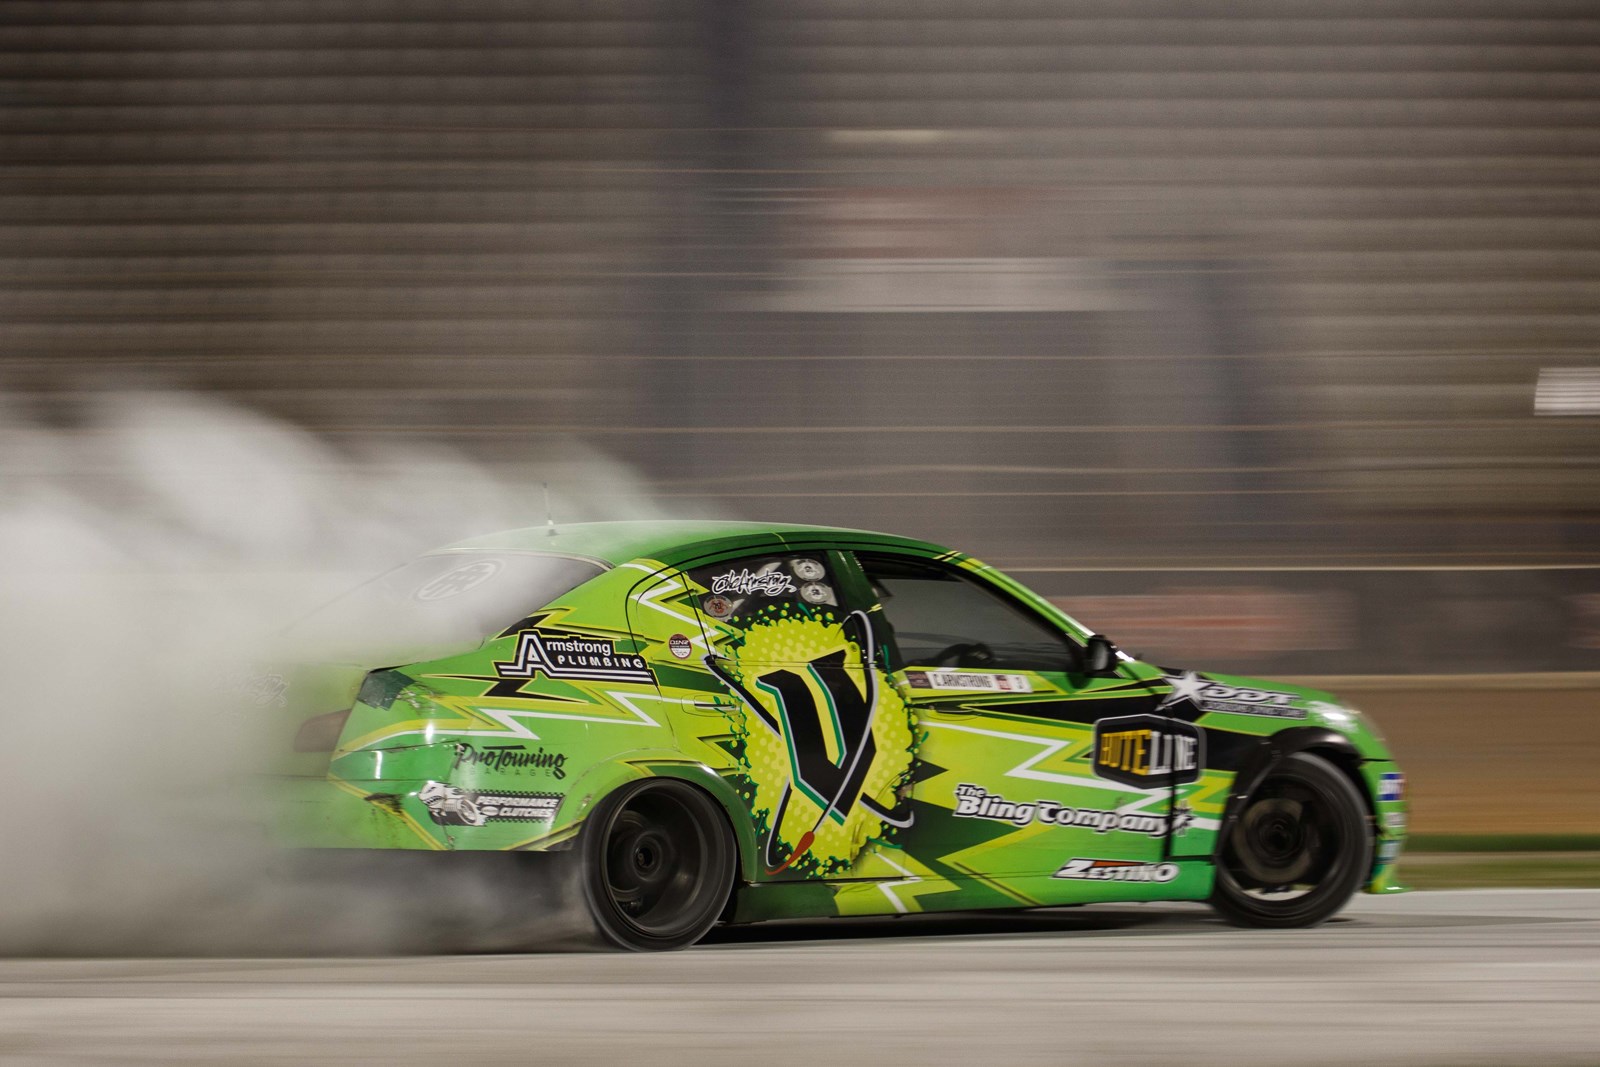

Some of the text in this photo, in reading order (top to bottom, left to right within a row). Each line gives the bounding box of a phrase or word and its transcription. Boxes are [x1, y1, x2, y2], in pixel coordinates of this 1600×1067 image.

[557, 654, 644, 669] PLUMBING
[955, 784, 987, 798] The
[955, 797, 1172, 836] Bling Company
